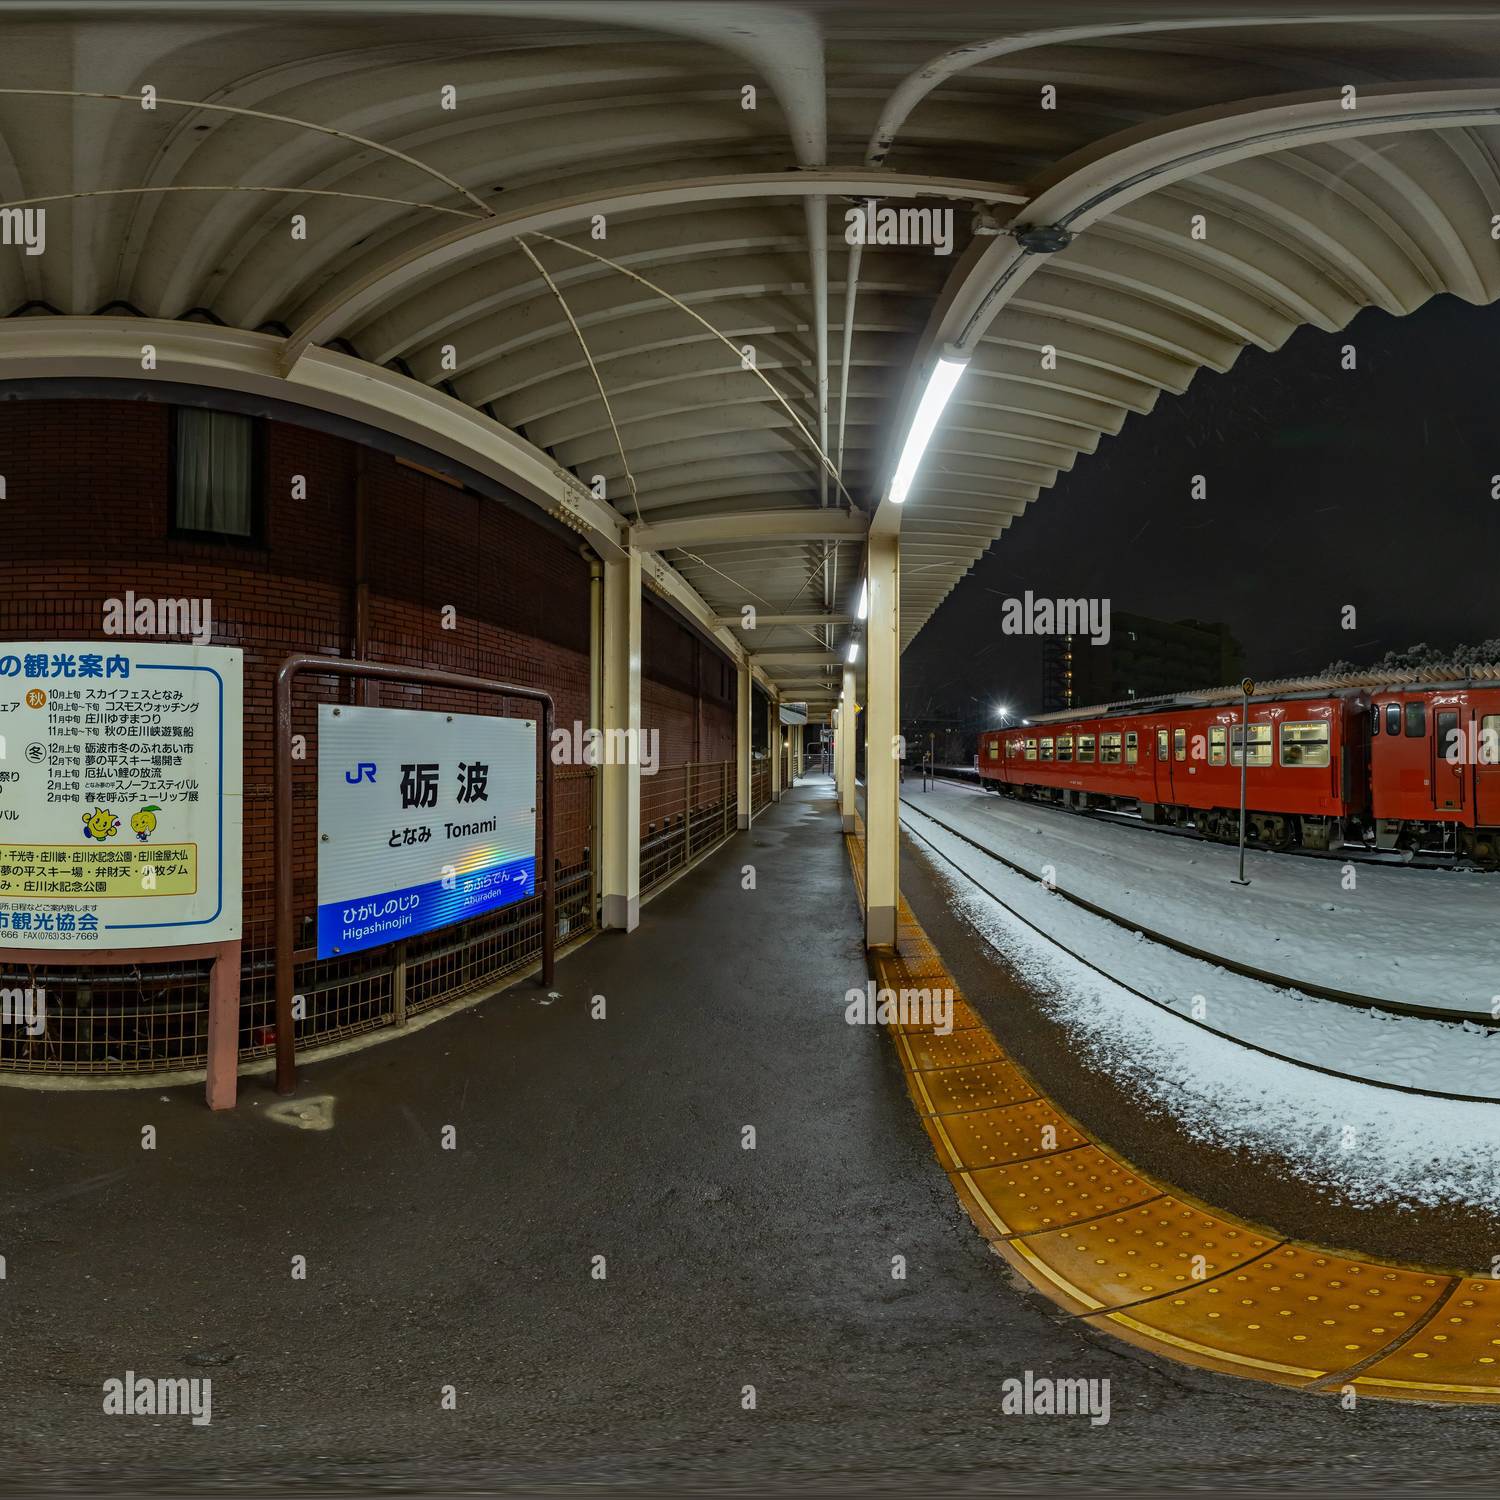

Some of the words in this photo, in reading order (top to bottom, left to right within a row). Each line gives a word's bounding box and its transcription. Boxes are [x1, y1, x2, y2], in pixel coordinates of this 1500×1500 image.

[0, 653, 130, 678] の観光案内
[29, 691, 43, 706] 秋
[48, 689, 81, 699] 10月上旬
[86, 689, 184, 701] スカイフェスとなみ
[106, 701, 200, 713] コスモスウォッチング
[48, 713, 81, 724] 11月中旬
[85, 713, 162, 725] 庄川ゆずまつり
[29, 745, 43, 760] 冬
[48, 743, 81, 754] 12月上旬
[85, 742, 194, 754] 砺波市冬のふれあい市
[48, 755, 81, 766] 12月下旬
[85, 755, 183, 766] 夢の平スキー場開き
[48, 768, 80, 778] 1月上旬
[85, 767, 162, 779] 厄払い鯉の放流
[345, 762, 377, 784] JR
[47, 780, 80, 790] 2月上旬
[400, 761, 490, 810] 砺波
[47, 792, 80, 803] 2月中旬
[85, 791, 199, 803] 春を呼ぶチューリップ展
[388, 825, 432, 848] となみ
[444, 816, 497, 840] Tonami
[463, 871, 510, 893] あぶらでん
[343, 893, 420, 924] ひがしのじり
[343, 914, 412, 941] Higashinojiri
